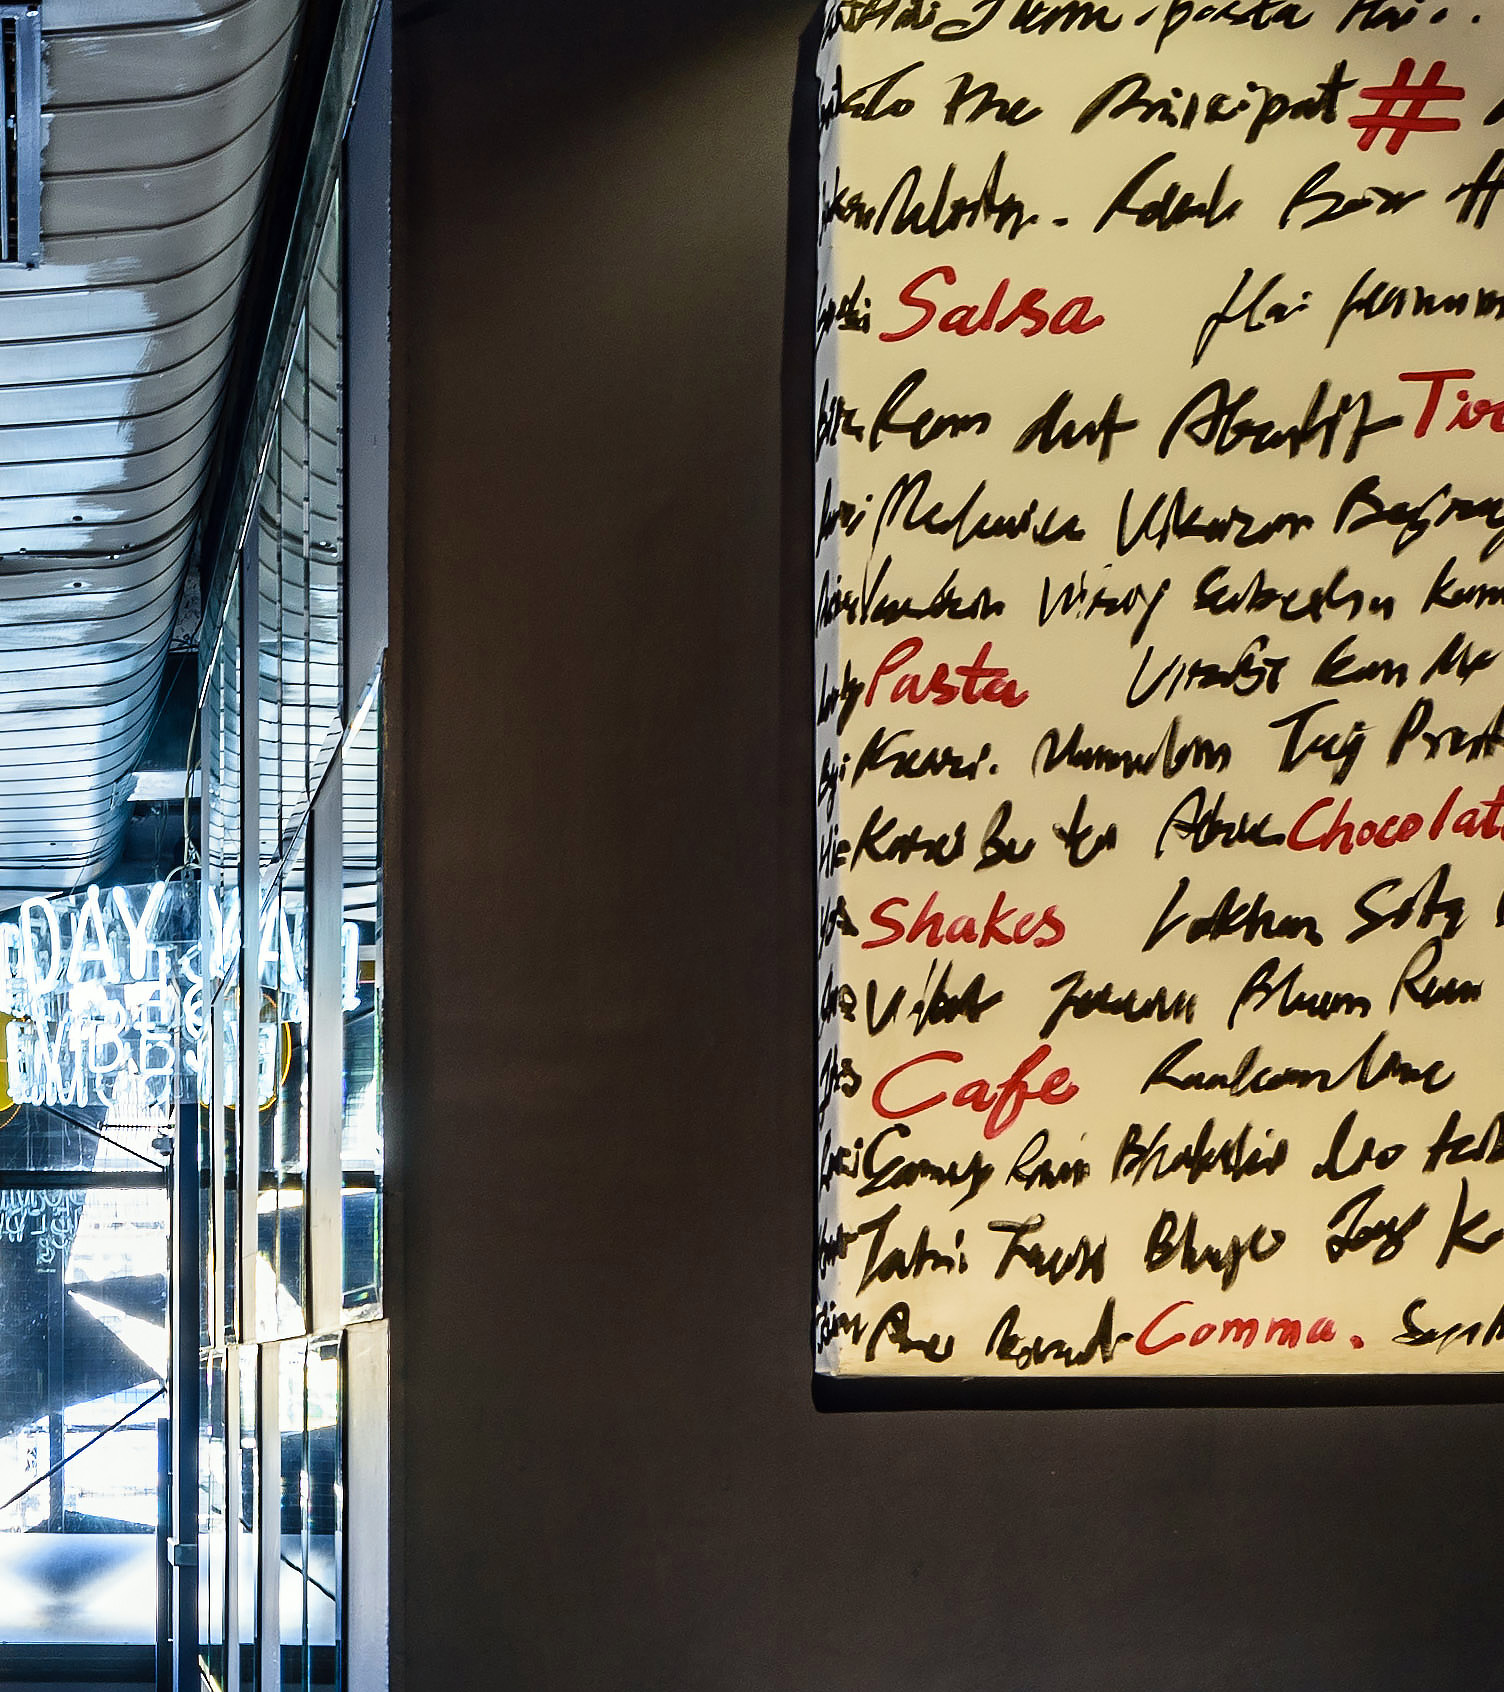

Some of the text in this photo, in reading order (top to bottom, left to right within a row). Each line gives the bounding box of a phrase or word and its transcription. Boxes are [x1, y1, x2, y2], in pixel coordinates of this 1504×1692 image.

[878, 265, 1105, 343] Salsa
[864, 636, 1029, 709] Pasta
[861, 890, 1066, 950] Shakes
[871, 1043, 1080, 1140] Cafe
